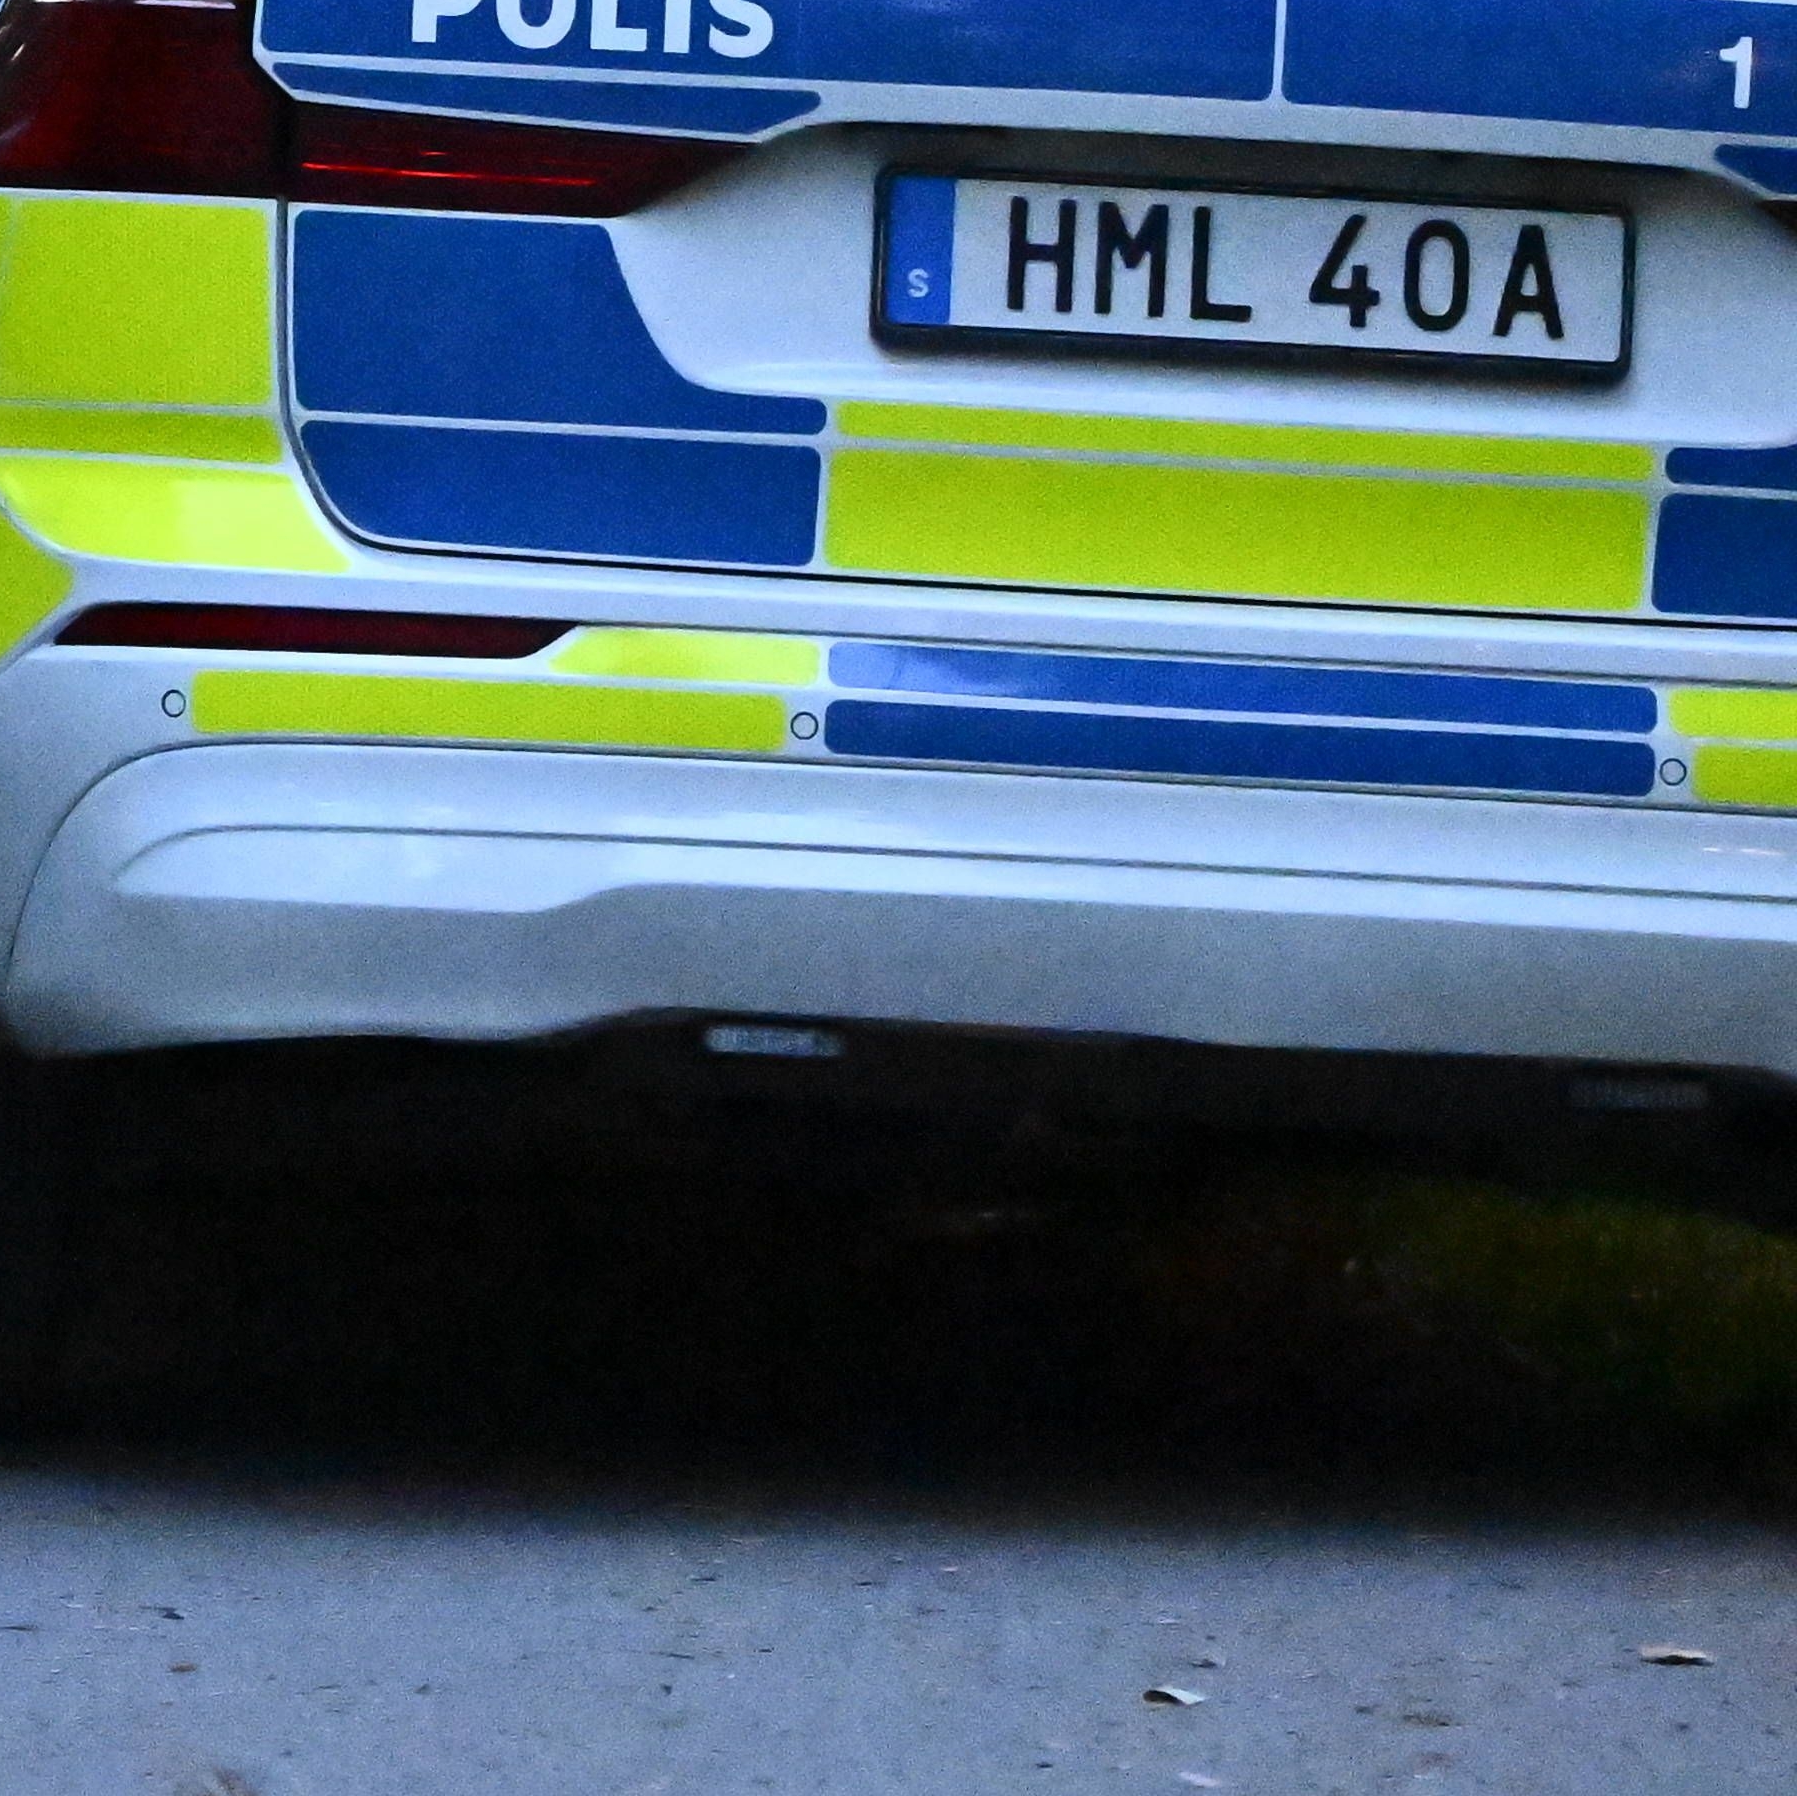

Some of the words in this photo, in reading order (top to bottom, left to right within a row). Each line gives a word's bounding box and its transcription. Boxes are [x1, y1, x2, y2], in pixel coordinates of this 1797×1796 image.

[1718, 36, 1753, 109] 1
[908, 268, 929, 298] S
[1006, 195, 1253, 323] HML
[1308, 213, 1566, 340] 40A
